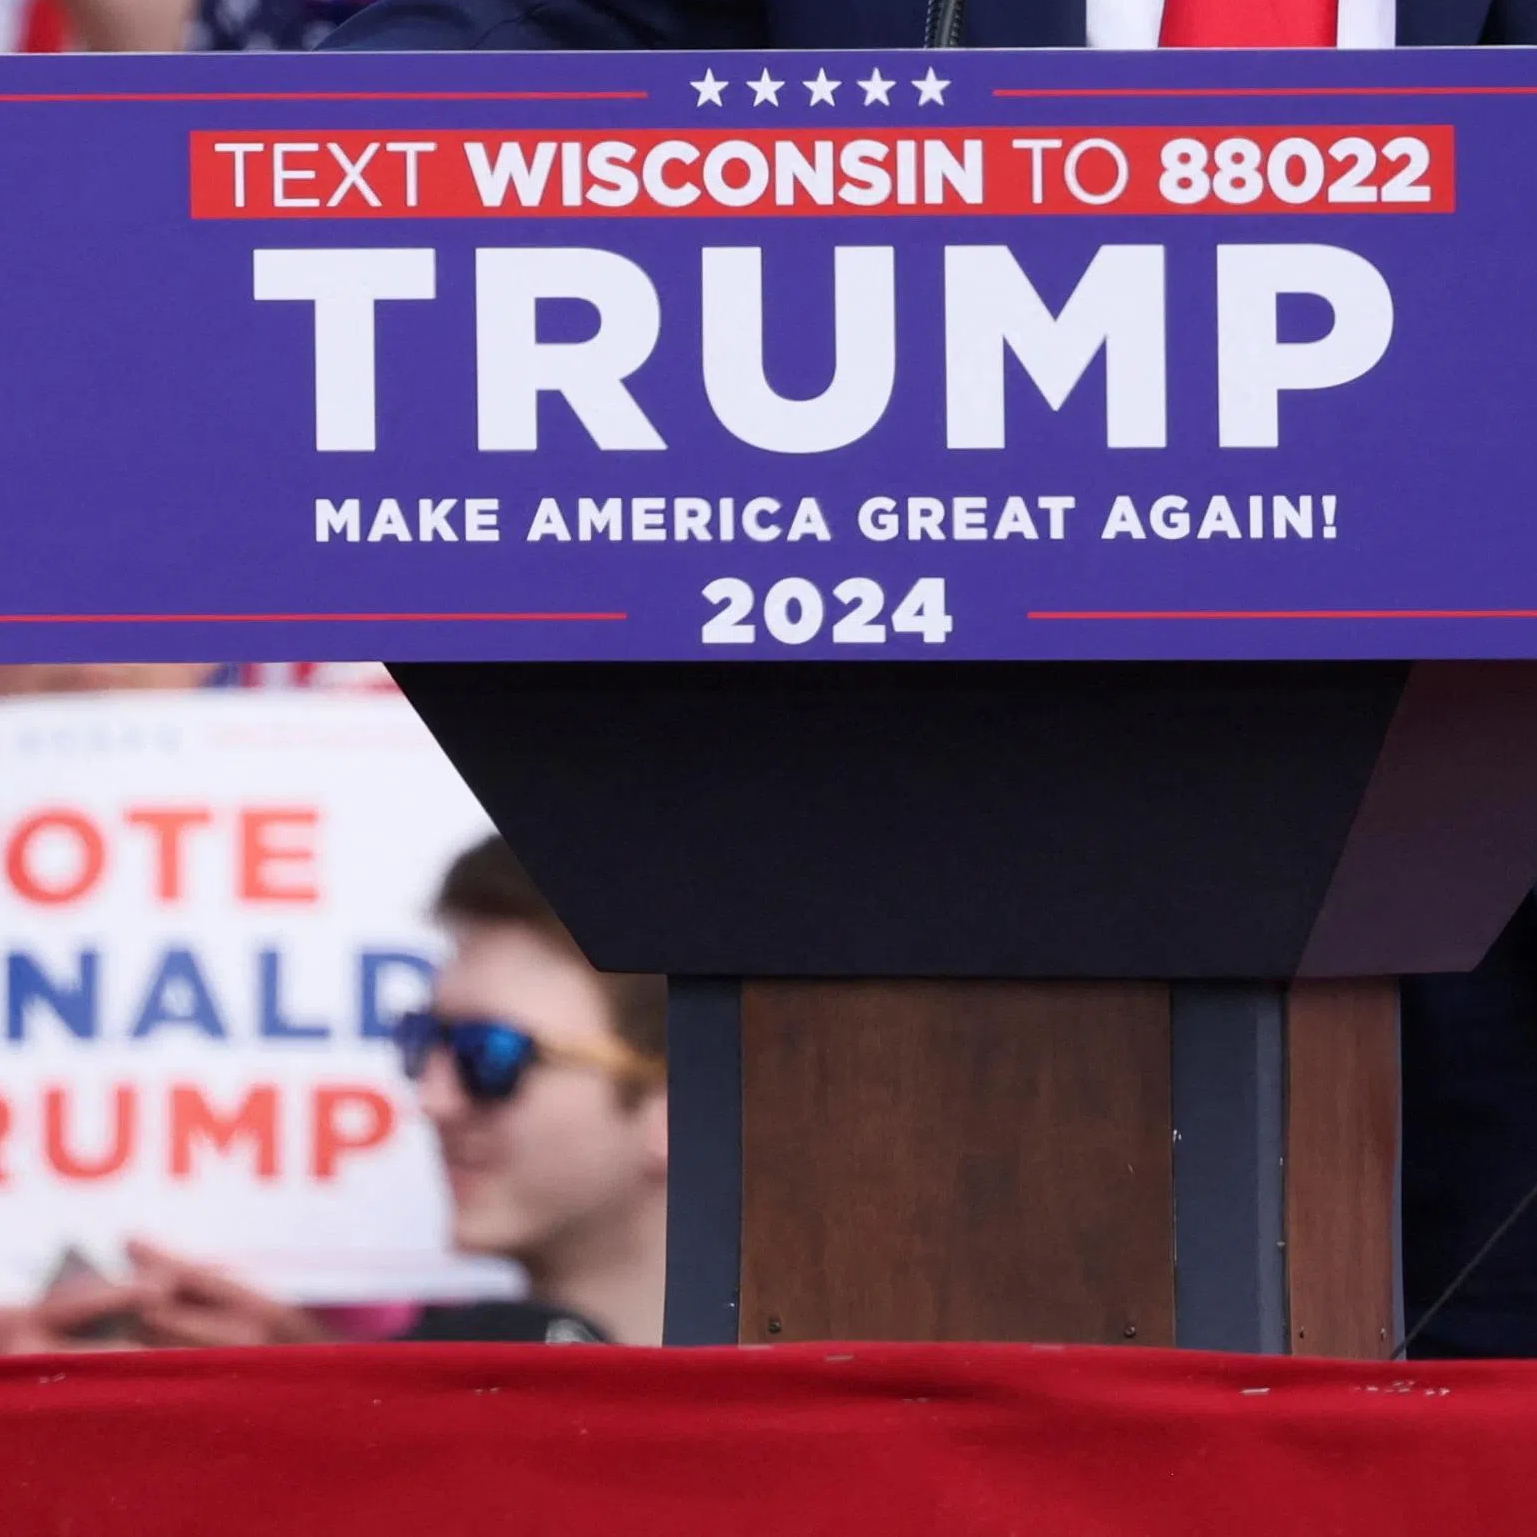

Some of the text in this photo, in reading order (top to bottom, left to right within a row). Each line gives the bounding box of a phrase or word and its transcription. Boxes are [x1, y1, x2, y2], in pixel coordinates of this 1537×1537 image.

[214, 137, 1431, 207] TEXT WISCONSIN TO 88022
[253, 243, 1394, 453] TRUMP
[315, 494, 1338, 542] MAKE AMERICA GREAT AGAIN!
[701, 576, 952, 646] 2024
